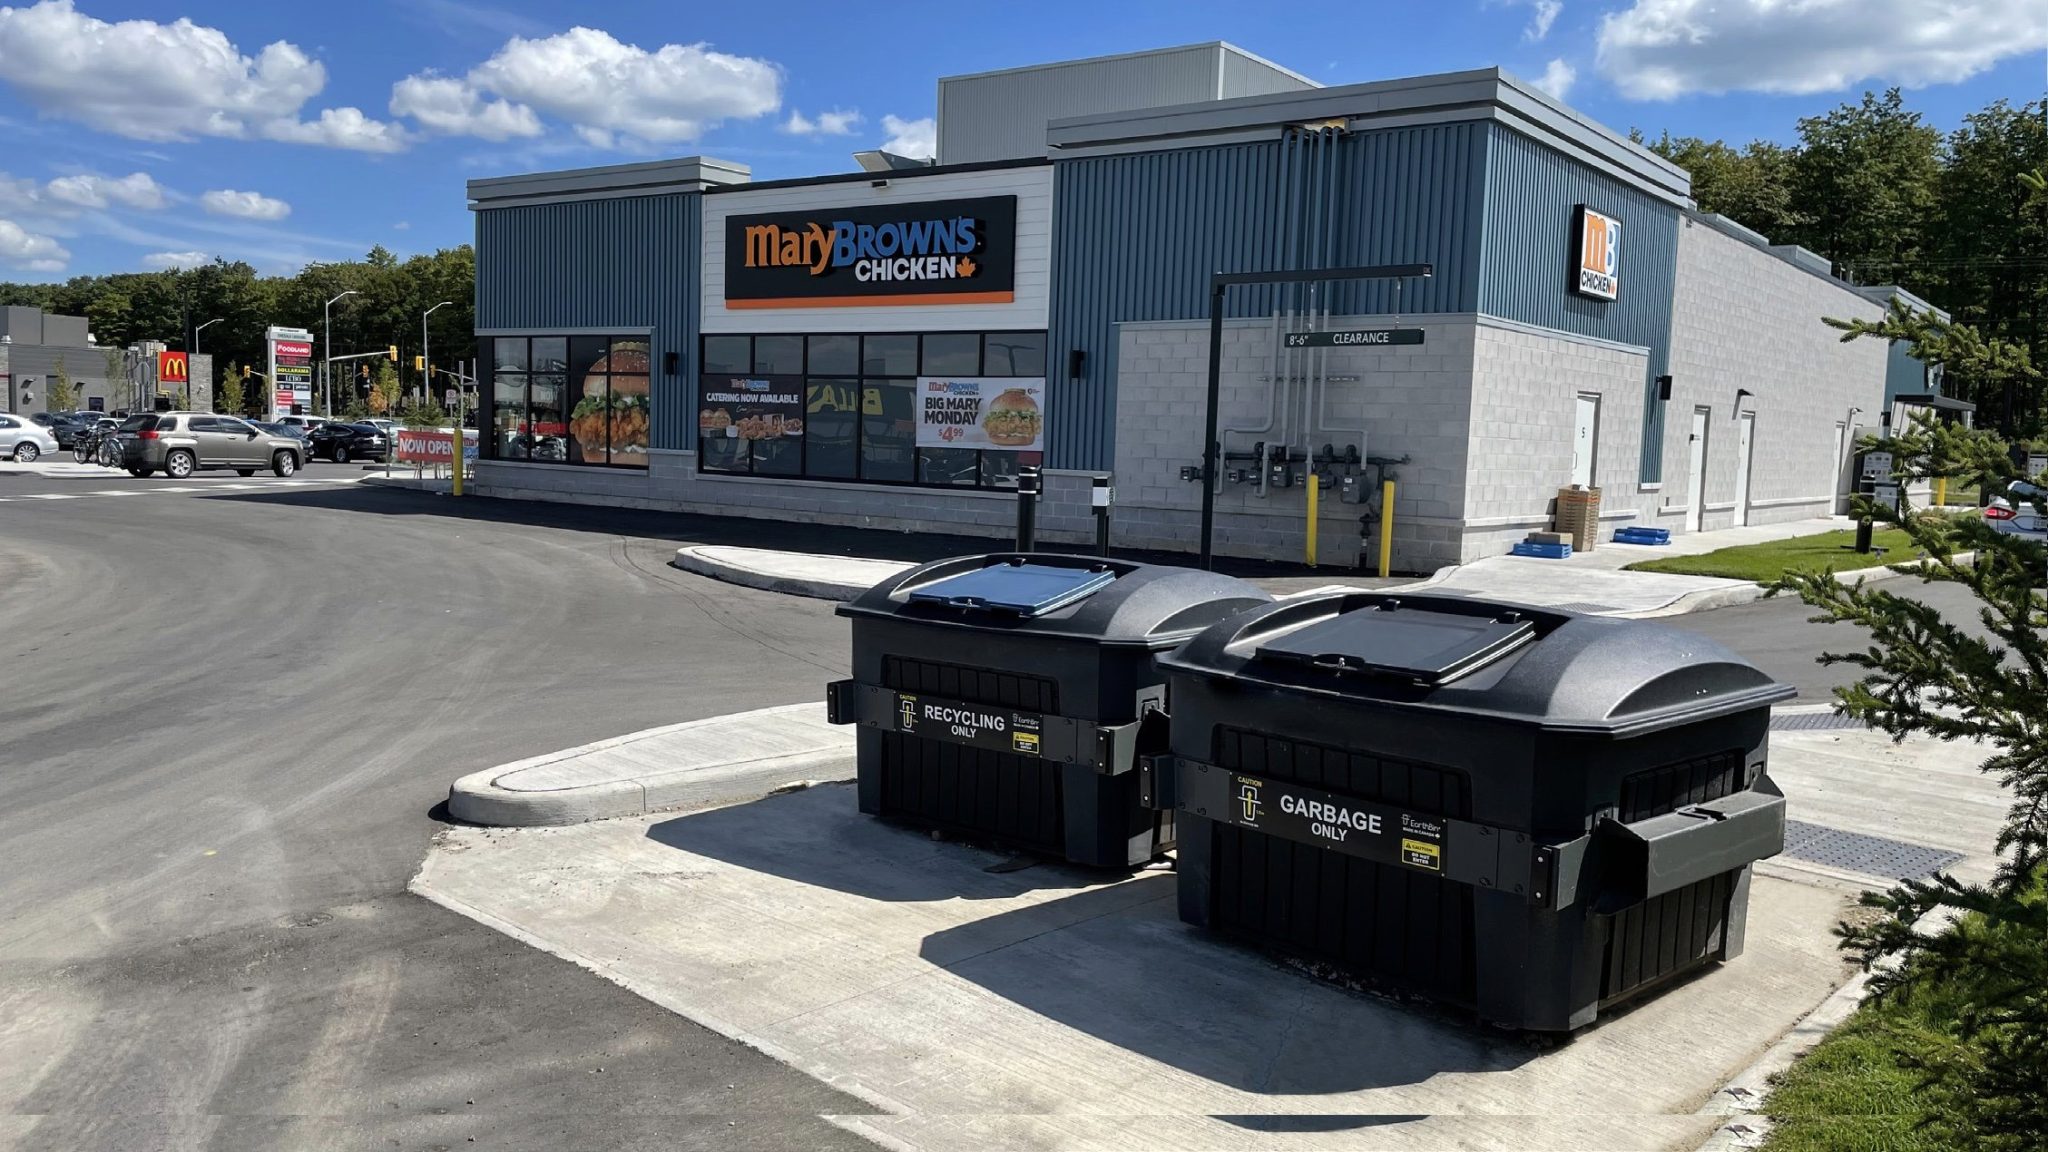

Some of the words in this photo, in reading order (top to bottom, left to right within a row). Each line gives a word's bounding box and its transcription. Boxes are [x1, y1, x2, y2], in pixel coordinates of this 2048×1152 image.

[855, 256, 956, 282] CHICKEN
[1581, 270, 1611, 293] CHICKEN
[1333, 332, 1389, 344] CLEARANCE
[706, 392, 740, 402] CATERING
[741, 393, 758, 403] NOW
[759, 394, 799, 404] AVAILABLE
[925, 397, 944, 410] BIG
[946, 397, 982, 411] MARY
[924, 410, 979, 425] MONDAY
[399, 437, 426, 454] NOW
[428, 440, 454, 455] OPEN
[924, 704, 1005, 732] RECYCLING
[951, 725, 977, 739] ONLY
[1237, 776, 1263, 787] CAUTION
[1280, 794, 1382, 835] GARBAGE
[1311, 822, 1348, 842] ONLY
